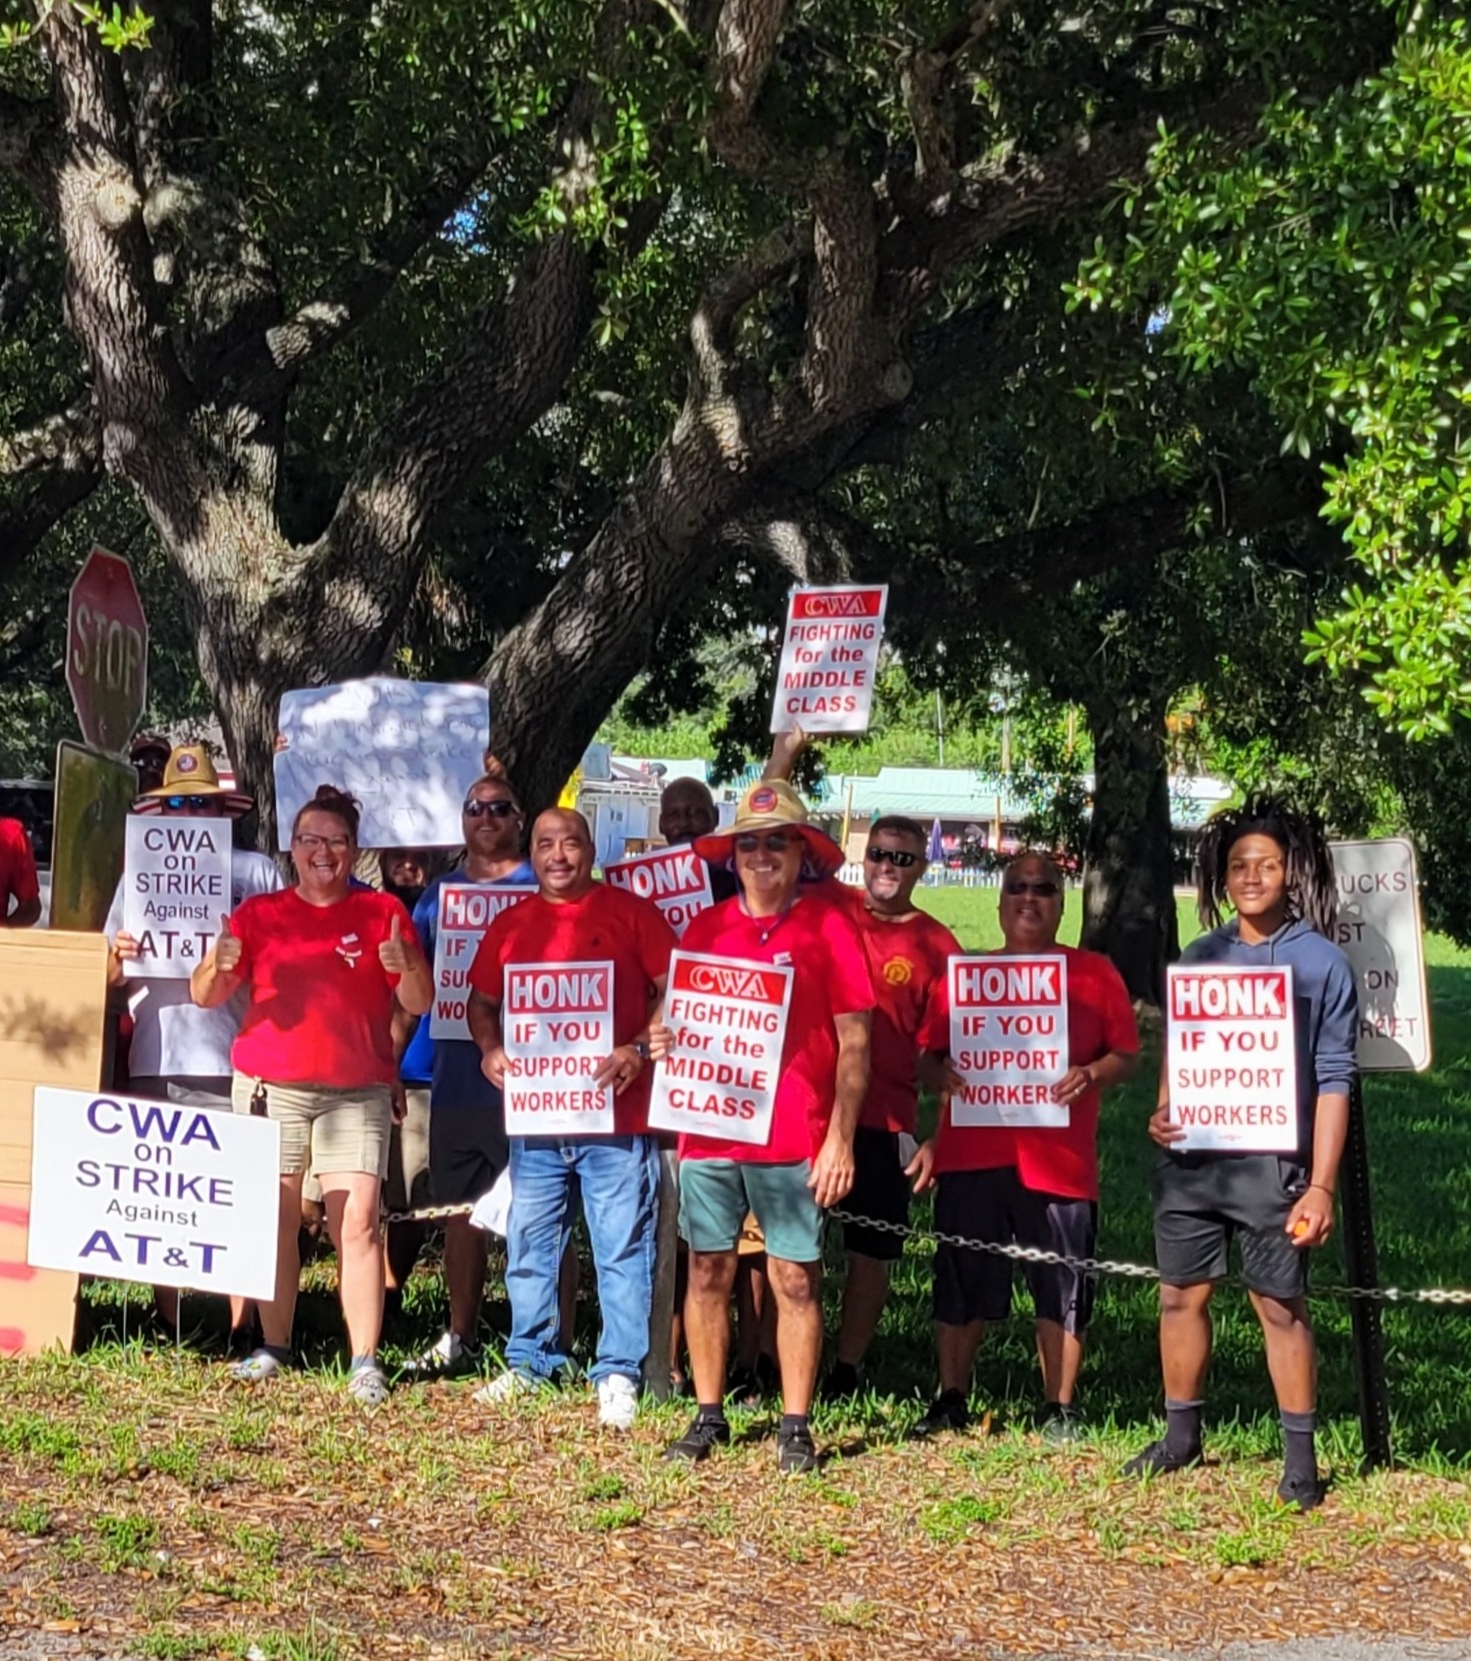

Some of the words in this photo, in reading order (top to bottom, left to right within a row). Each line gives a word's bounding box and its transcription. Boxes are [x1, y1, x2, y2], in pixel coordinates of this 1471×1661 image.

[805, 594, 867, 615] CWA
[789, 623, 875, 642] FIGHTING
[74, 603, 142, 696] STOP
[795, 647, 823, 663] for
[831, 645, 863, 662] the
[784, 670, 866, 689] MIDDLE
[786, 695, 857, 714] CLASS
[144, 828, 216, 853] CWA
[164, 854, 196, 871] on
[136, 872, 222, 896] STRIKE
[1341, 872, 1407, 894] UCKS
[143, 900, 209, 921] Against
[137, 930, 215, 960] AT&T
[446, 938, 467, 956] IF
[512, 973, 603, 1008] HONK
[690, 965, 769, 999] CWA
[958, 966, 1057, 1001] HONK
[1175, 978, 1281, 1016] HONK
[670, 998, 778, 1033] FIGHTING
[962, 1016, 986, 1036] IF
[996, 1015, 1054, 1036] YOU
[515, 1023, 537, 1043] IF
[546, 1021, 601, 1042] YOU
[1360, 1016, 1417, 1038] REET
[676, 1027, 713, 1050] for
[723, 1035, 765, 1059] the
[1181, 1031, 1205, 1051] IF
[1217, 1031, 1279, 1051] YOU
[959, 1050, 1059, 1070] SUPPORT
[665, 1055, 768, 1091] MIDDLE
[1178, 1068, 1285, 1088] SUPPORT
[510, 1090, 606, 1112] WORKERS
[668, 1088, 756, 1120] CLASS
[87, 1099, 221, 1150] CWA
[1177, 1105, 1287, 1126] WORKERS
[134, 1143, 172, 1165] on
[76, 1160, 233, 1206] STRIKE
[106, 1199, 198, 1228] Against
[78, 1229, 227, 1274] AT&T
